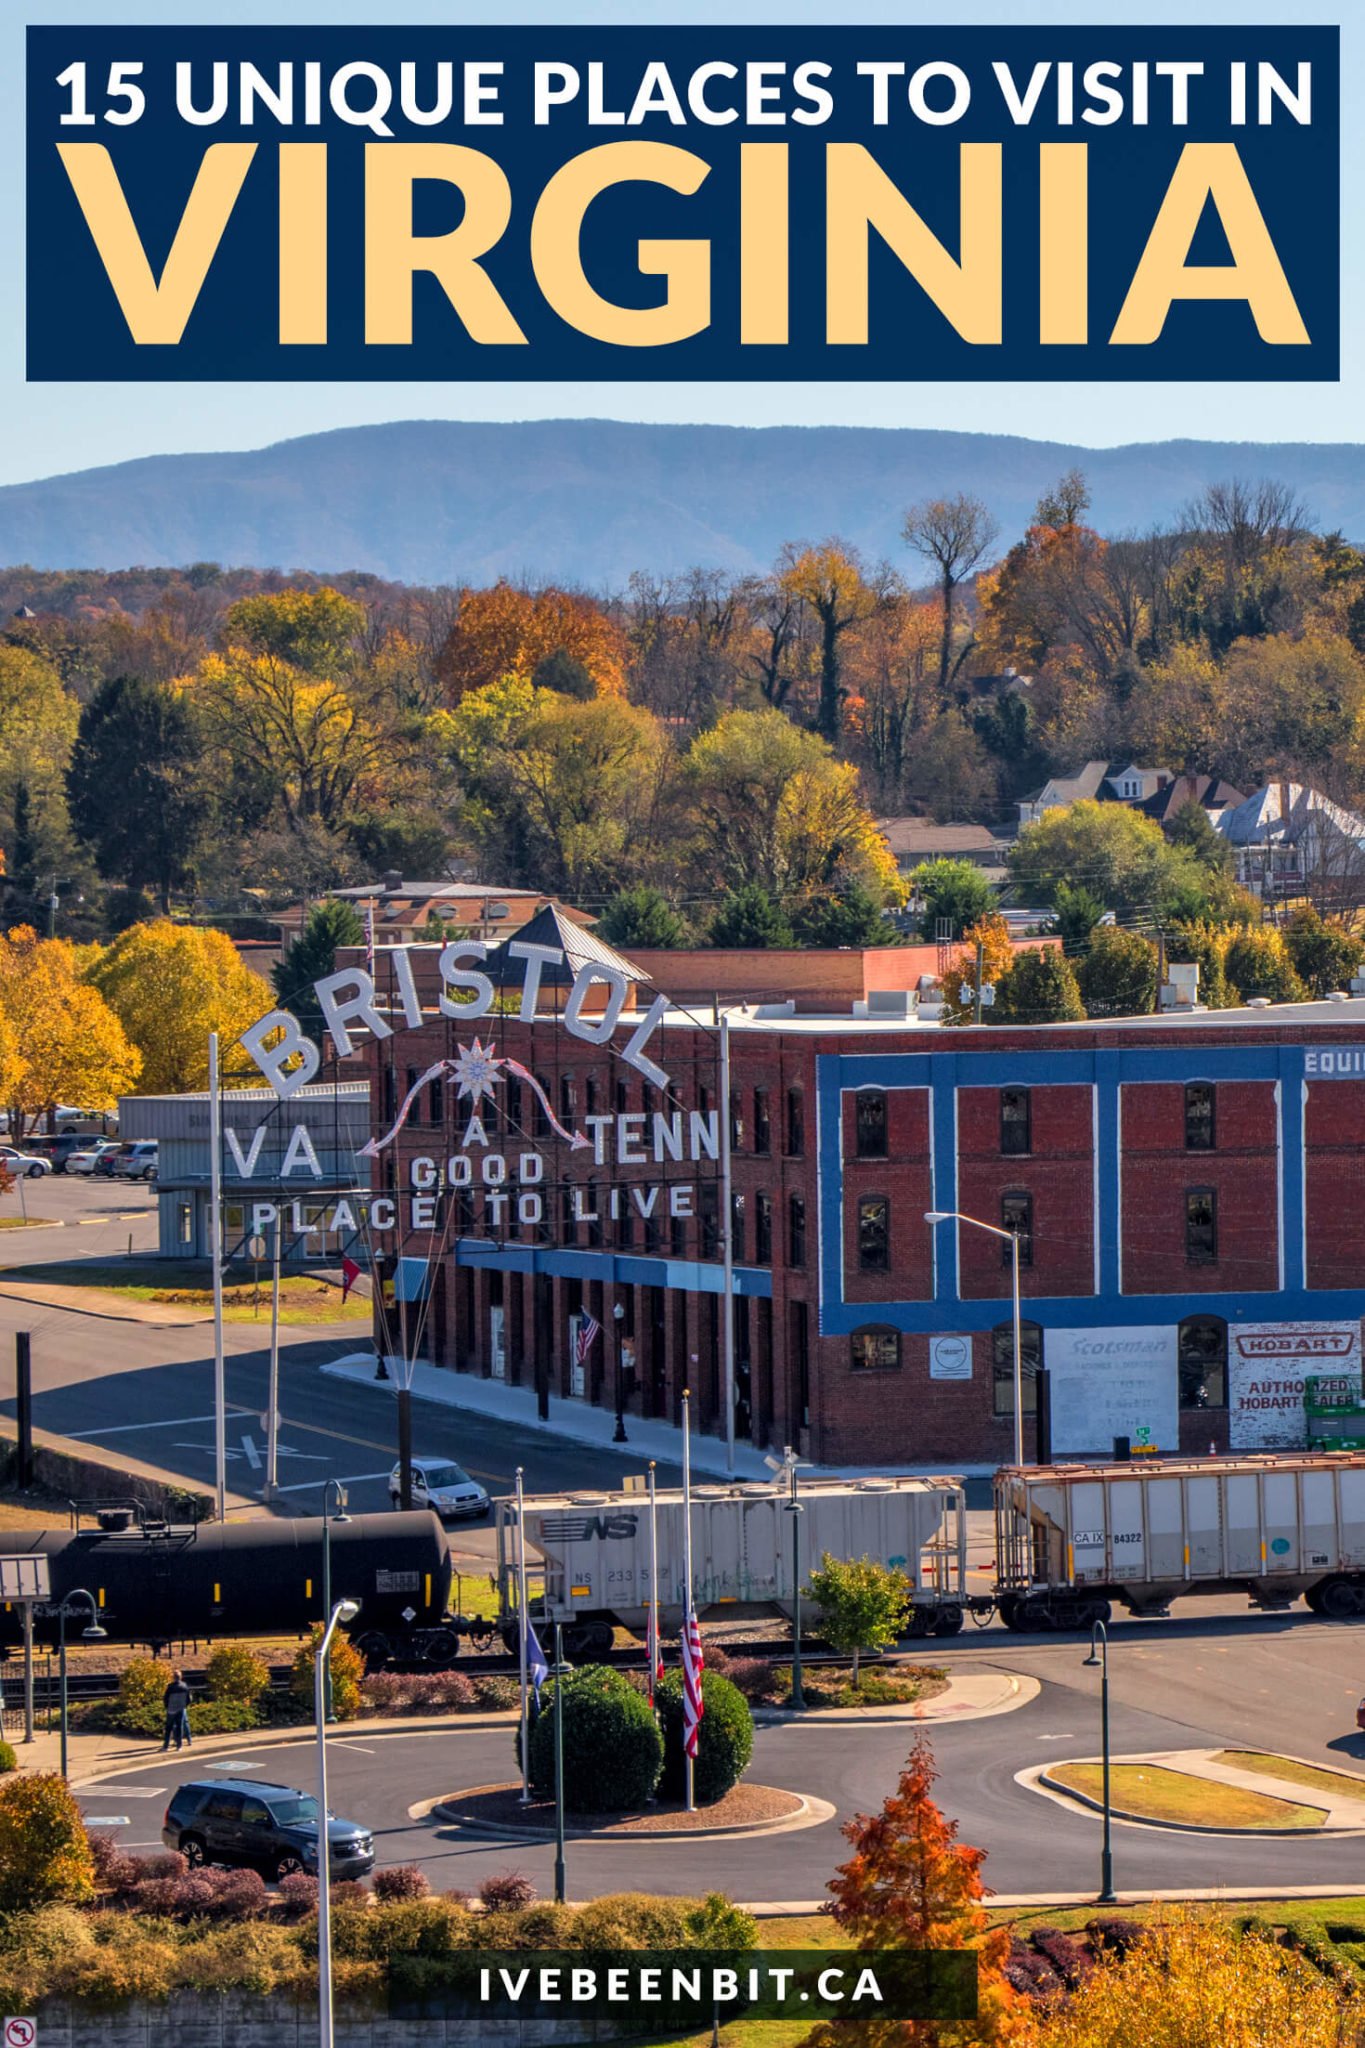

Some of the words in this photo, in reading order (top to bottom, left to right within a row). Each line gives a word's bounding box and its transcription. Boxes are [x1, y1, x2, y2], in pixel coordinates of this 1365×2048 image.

[240, 940, 671, 1099] BRISTOL
[225, 1124, 323, 1179] VA
[584, 1110, 720, 1165] TENN
[462, 1115, 490, 1148] A
[410, 1152, 544, 1188] GOOD
[252, 1197, 437, 1235] PLACE
[485, 1193, 543, 1225] TO
[574, 1185, 695, 1222] LIVE
[1249, 1338, 1343, 1352] HOBART
[1248, 1379, 1348, 1395] AUTHOIZED
[1239, 1396, 1300, 1410] HOBART
[582, 1514, 639, 1540] NS
[575, 1572, 592, 1583] NS
